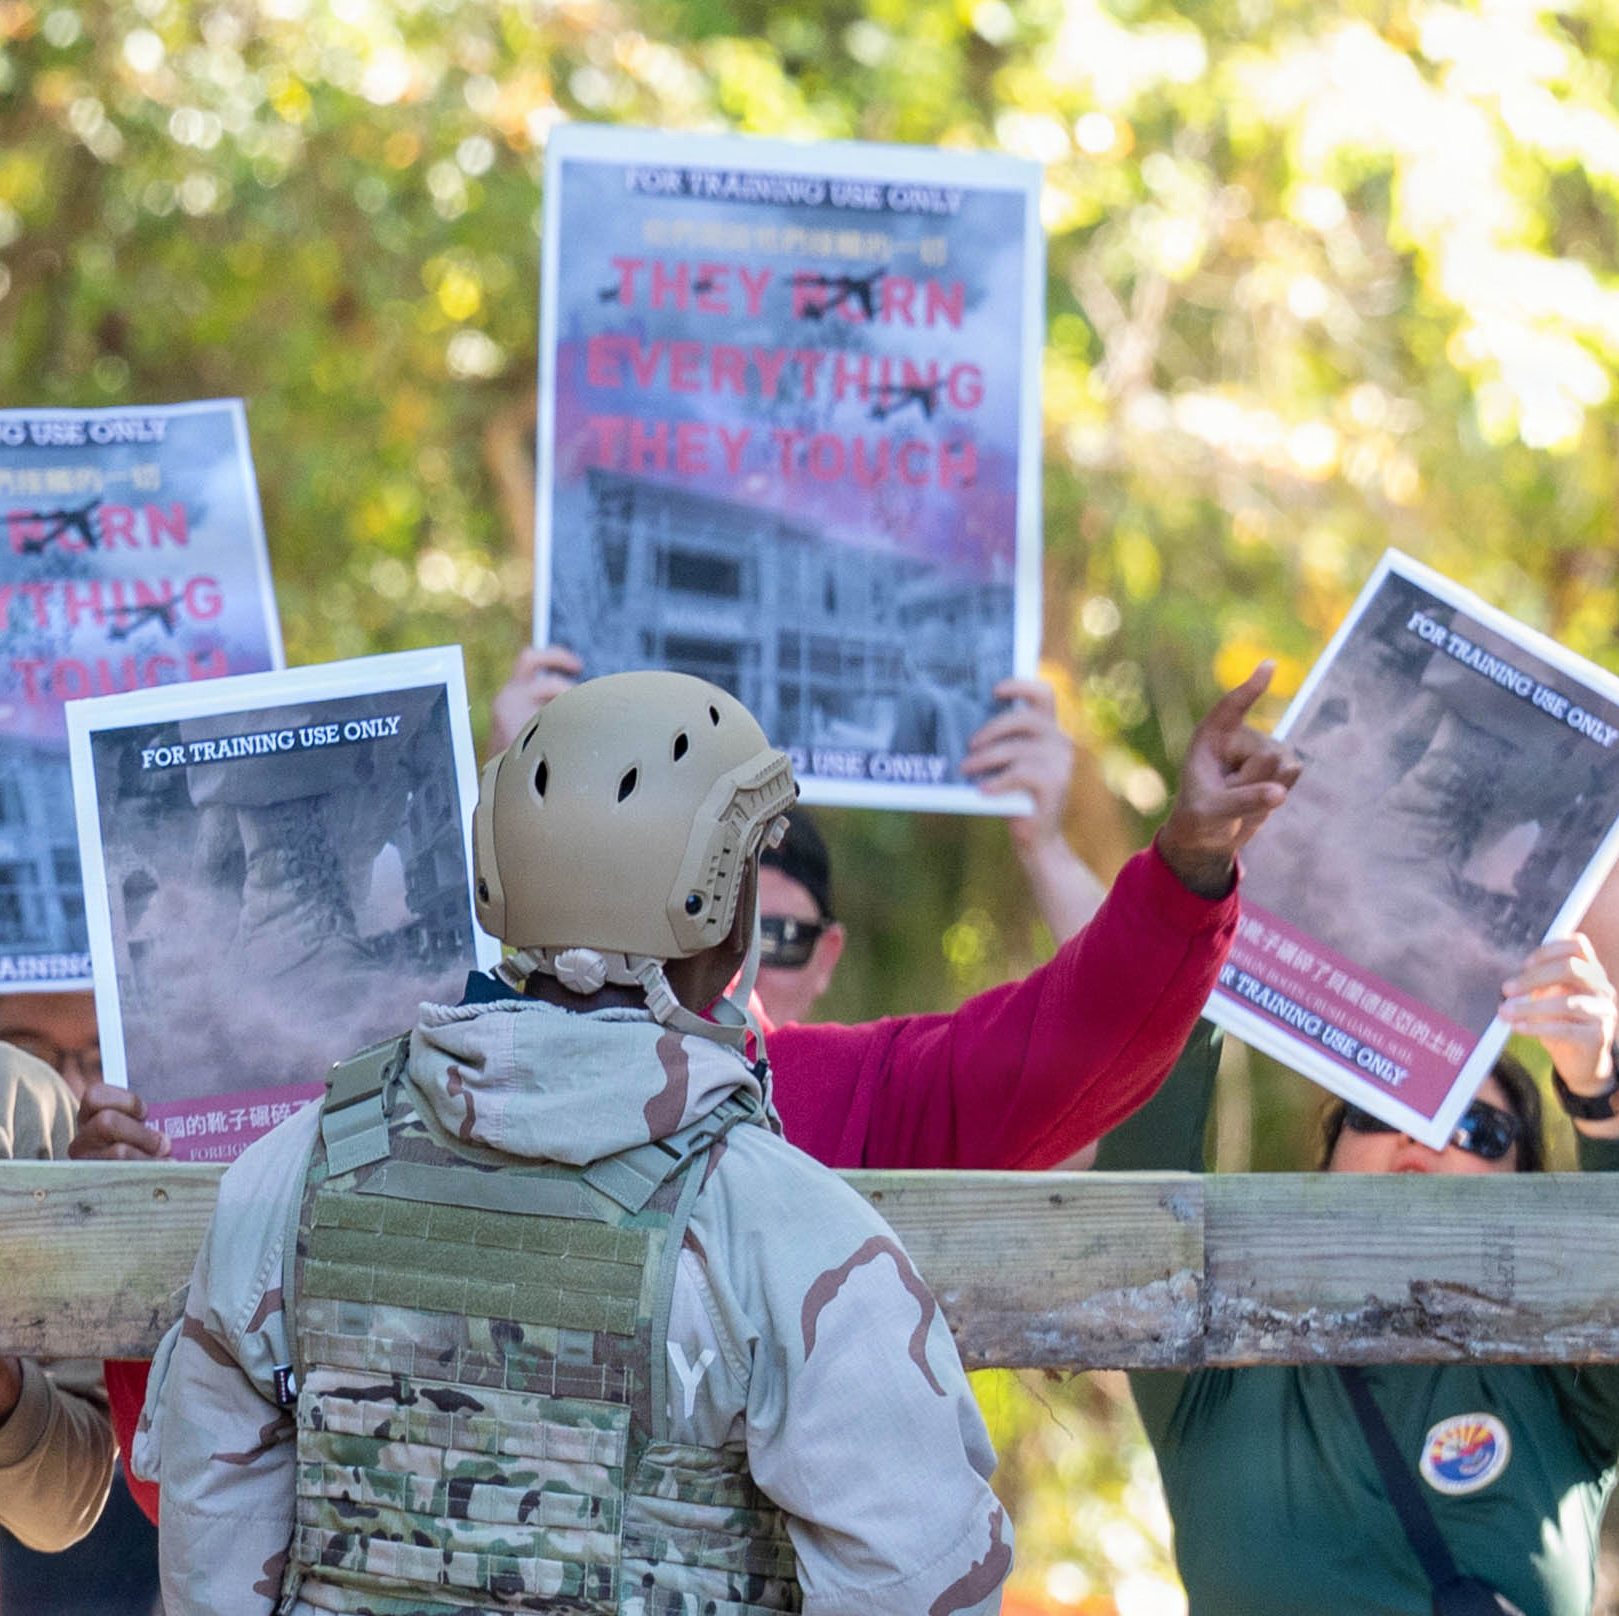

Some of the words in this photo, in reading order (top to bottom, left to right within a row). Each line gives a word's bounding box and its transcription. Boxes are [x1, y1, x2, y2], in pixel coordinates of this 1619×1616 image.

[625, 168, 683, 197] FOR
[687, 172, 826, 207] TRAINING
[830, 181, 882, 211] USE
[887, 184, 961, 215] ONLY
[611, 258, 773, 318] THEY
[586, 333, 984, 410] EVERYTHING
[31, 420, 86, 447] USE
[90, 418, 166, 444] ONLY
[588, 415, 750, 477] THEY
[775, 429, 979, 491] TOUCH
[11, 649, 229, 704] TOUCH
[1407, 610, 1447, 648] FOR
[1447, 632, 1535, 698] TRAINING
[1531, 683, 1570, 721] USE
[142, 746, 187, 770] FOR
[189, 729, 295, 764] TRAINING
[299, 724, 340, 747] USE
[344, 715, 401, 739] ONLY
[812, 749, 864, 779] USE
[869, 753, 947, 784] ONLY
[1237, 971, 1322, 1037] TRAINING
[1321, 1022, 1360, 1060] USE
[1356, 1046, 1409, 1088] ONLY
